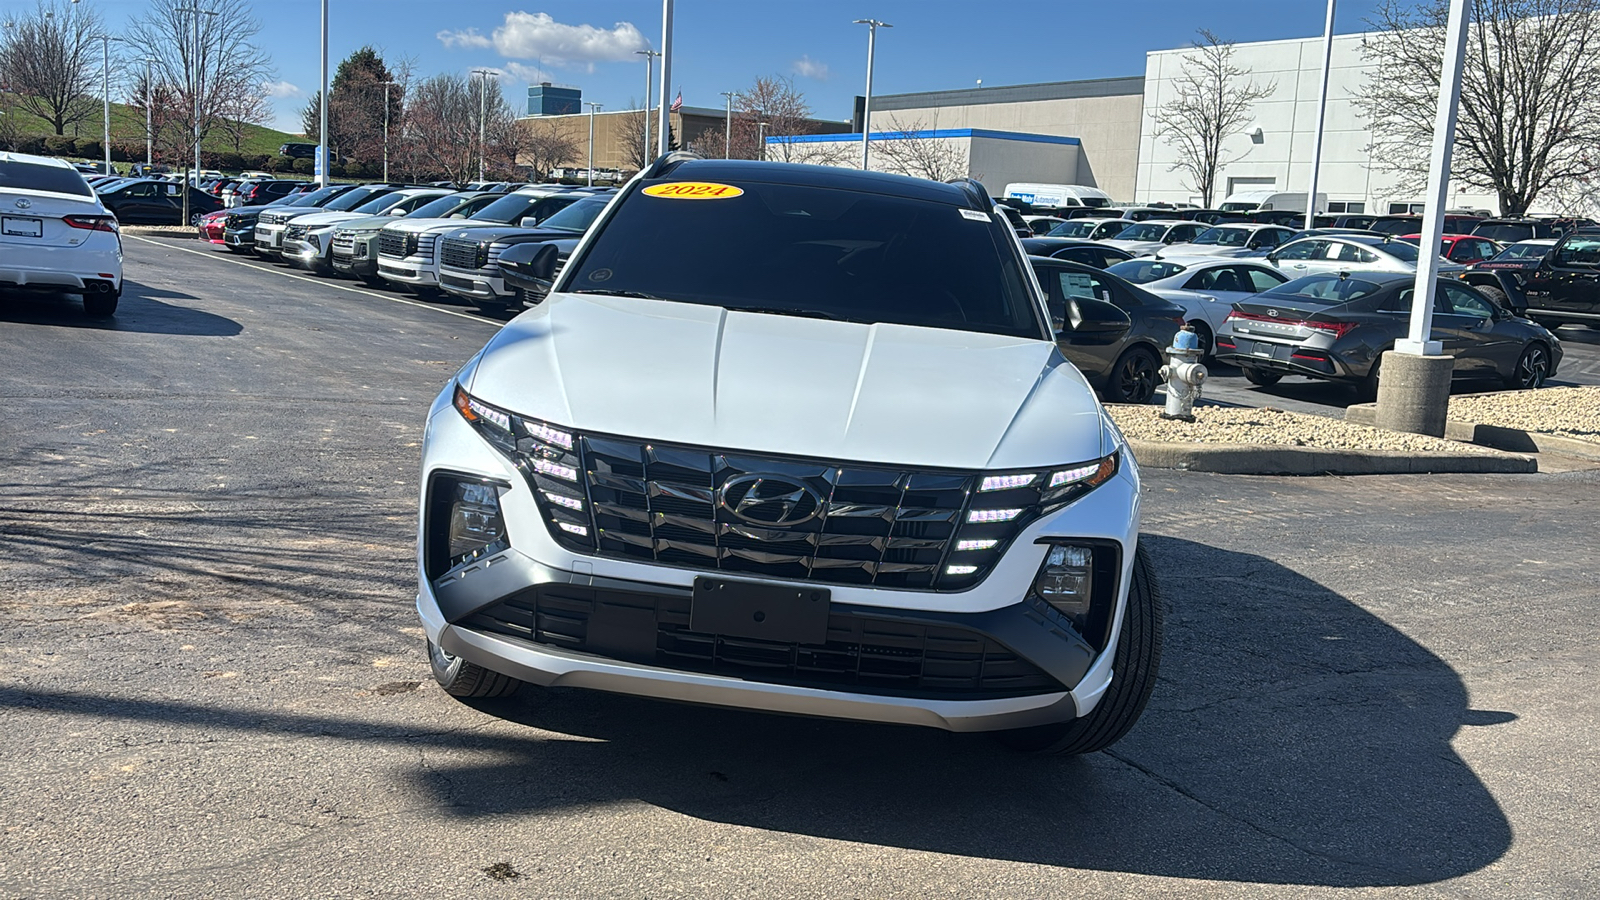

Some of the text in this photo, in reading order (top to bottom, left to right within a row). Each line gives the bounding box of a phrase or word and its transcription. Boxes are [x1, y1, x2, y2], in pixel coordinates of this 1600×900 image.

[657, 186, 728, 196] 2024
[1034, 196, 1060, 205] Automotive
[1248, 321, 1293, 331] ELANTRA
